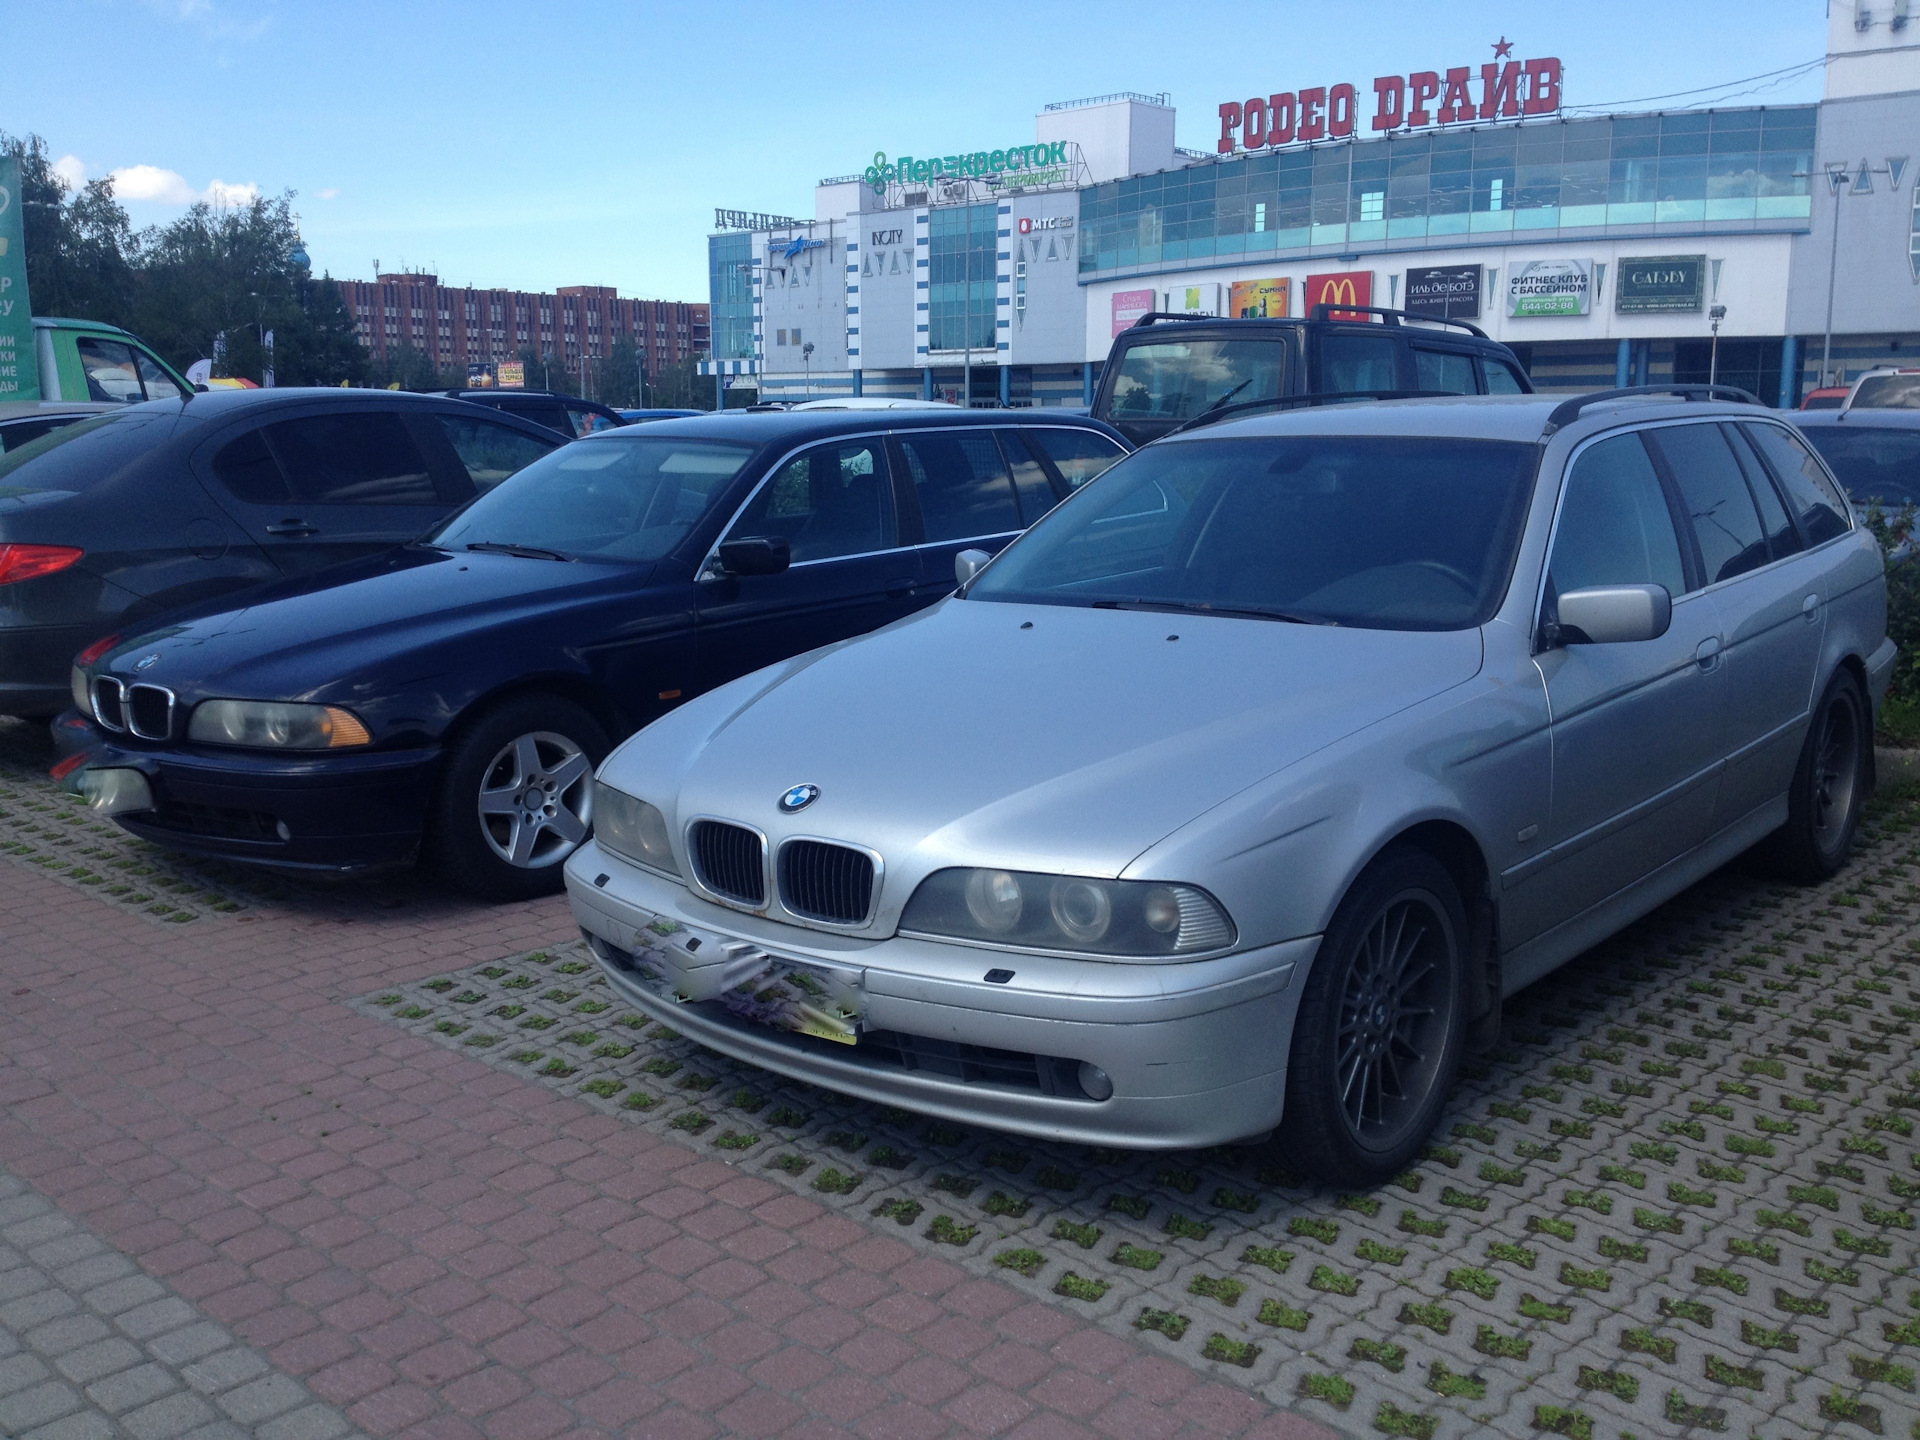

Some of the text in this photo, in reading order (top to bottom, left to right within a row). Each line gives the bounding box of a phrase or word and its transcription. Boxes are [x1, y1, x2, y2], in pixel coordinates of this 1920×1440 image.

[1032, 217, 1056, 231] МТС
[871, 229, 904, 246] INCITY
[1511, 274, 1588, 285] ФИТНЕС КЛУБ
[1632, 270, 1687, 285] GATSBY
[1411, 284, 1431, 294] ИЛЬ
[1511, 283, 1587, 295] С БАССЕЙНОМ
[1521, 302, 1574, 311] 644-02-88
